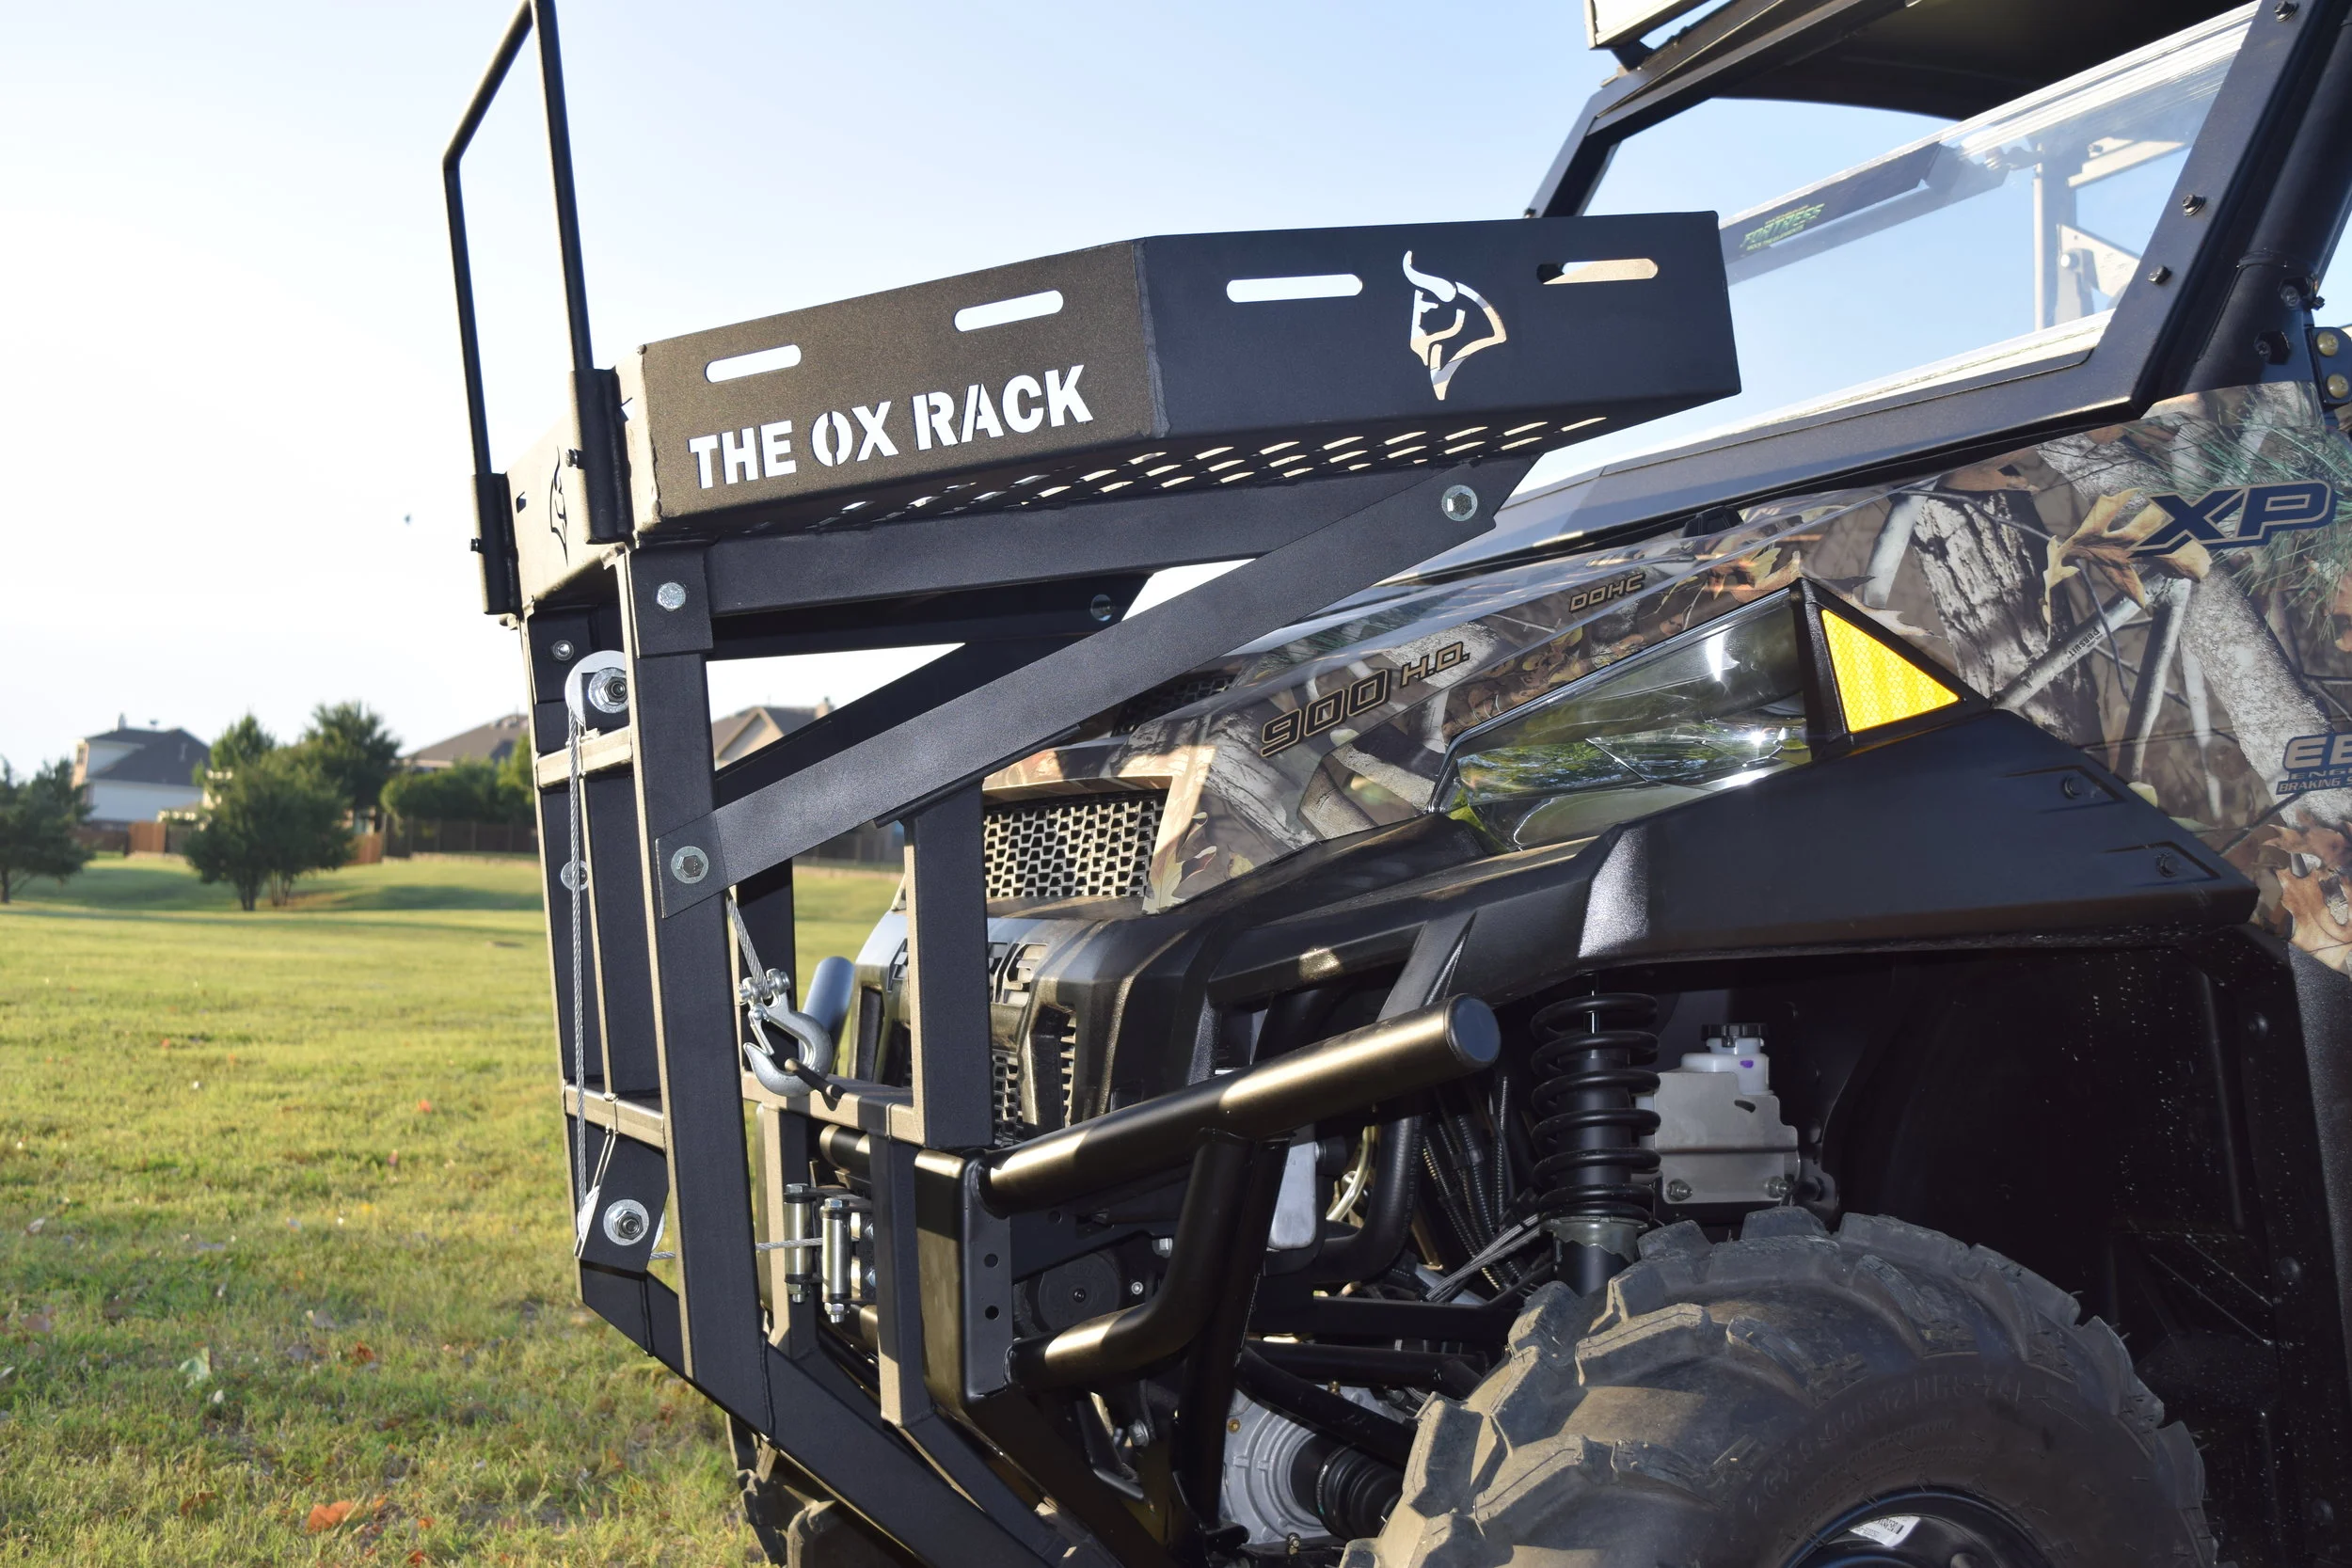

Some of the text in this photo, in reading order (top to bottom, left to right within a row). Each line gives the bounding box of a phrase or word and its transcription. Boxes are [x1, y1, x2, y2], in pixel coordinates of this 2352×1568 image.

[1740, 203, 1825, 248] FORTRESS
[688, 363, 1094, 490] THE OX RACK
[2129, 480, 2337, 558] XP
[1569, 572, 1647, 612] DOHC
[2067, 626, 2101, 657] PURSUIT
[1261, 668, 1392, 758] 900
[2279, 778, 2341, 792] BRAKING
